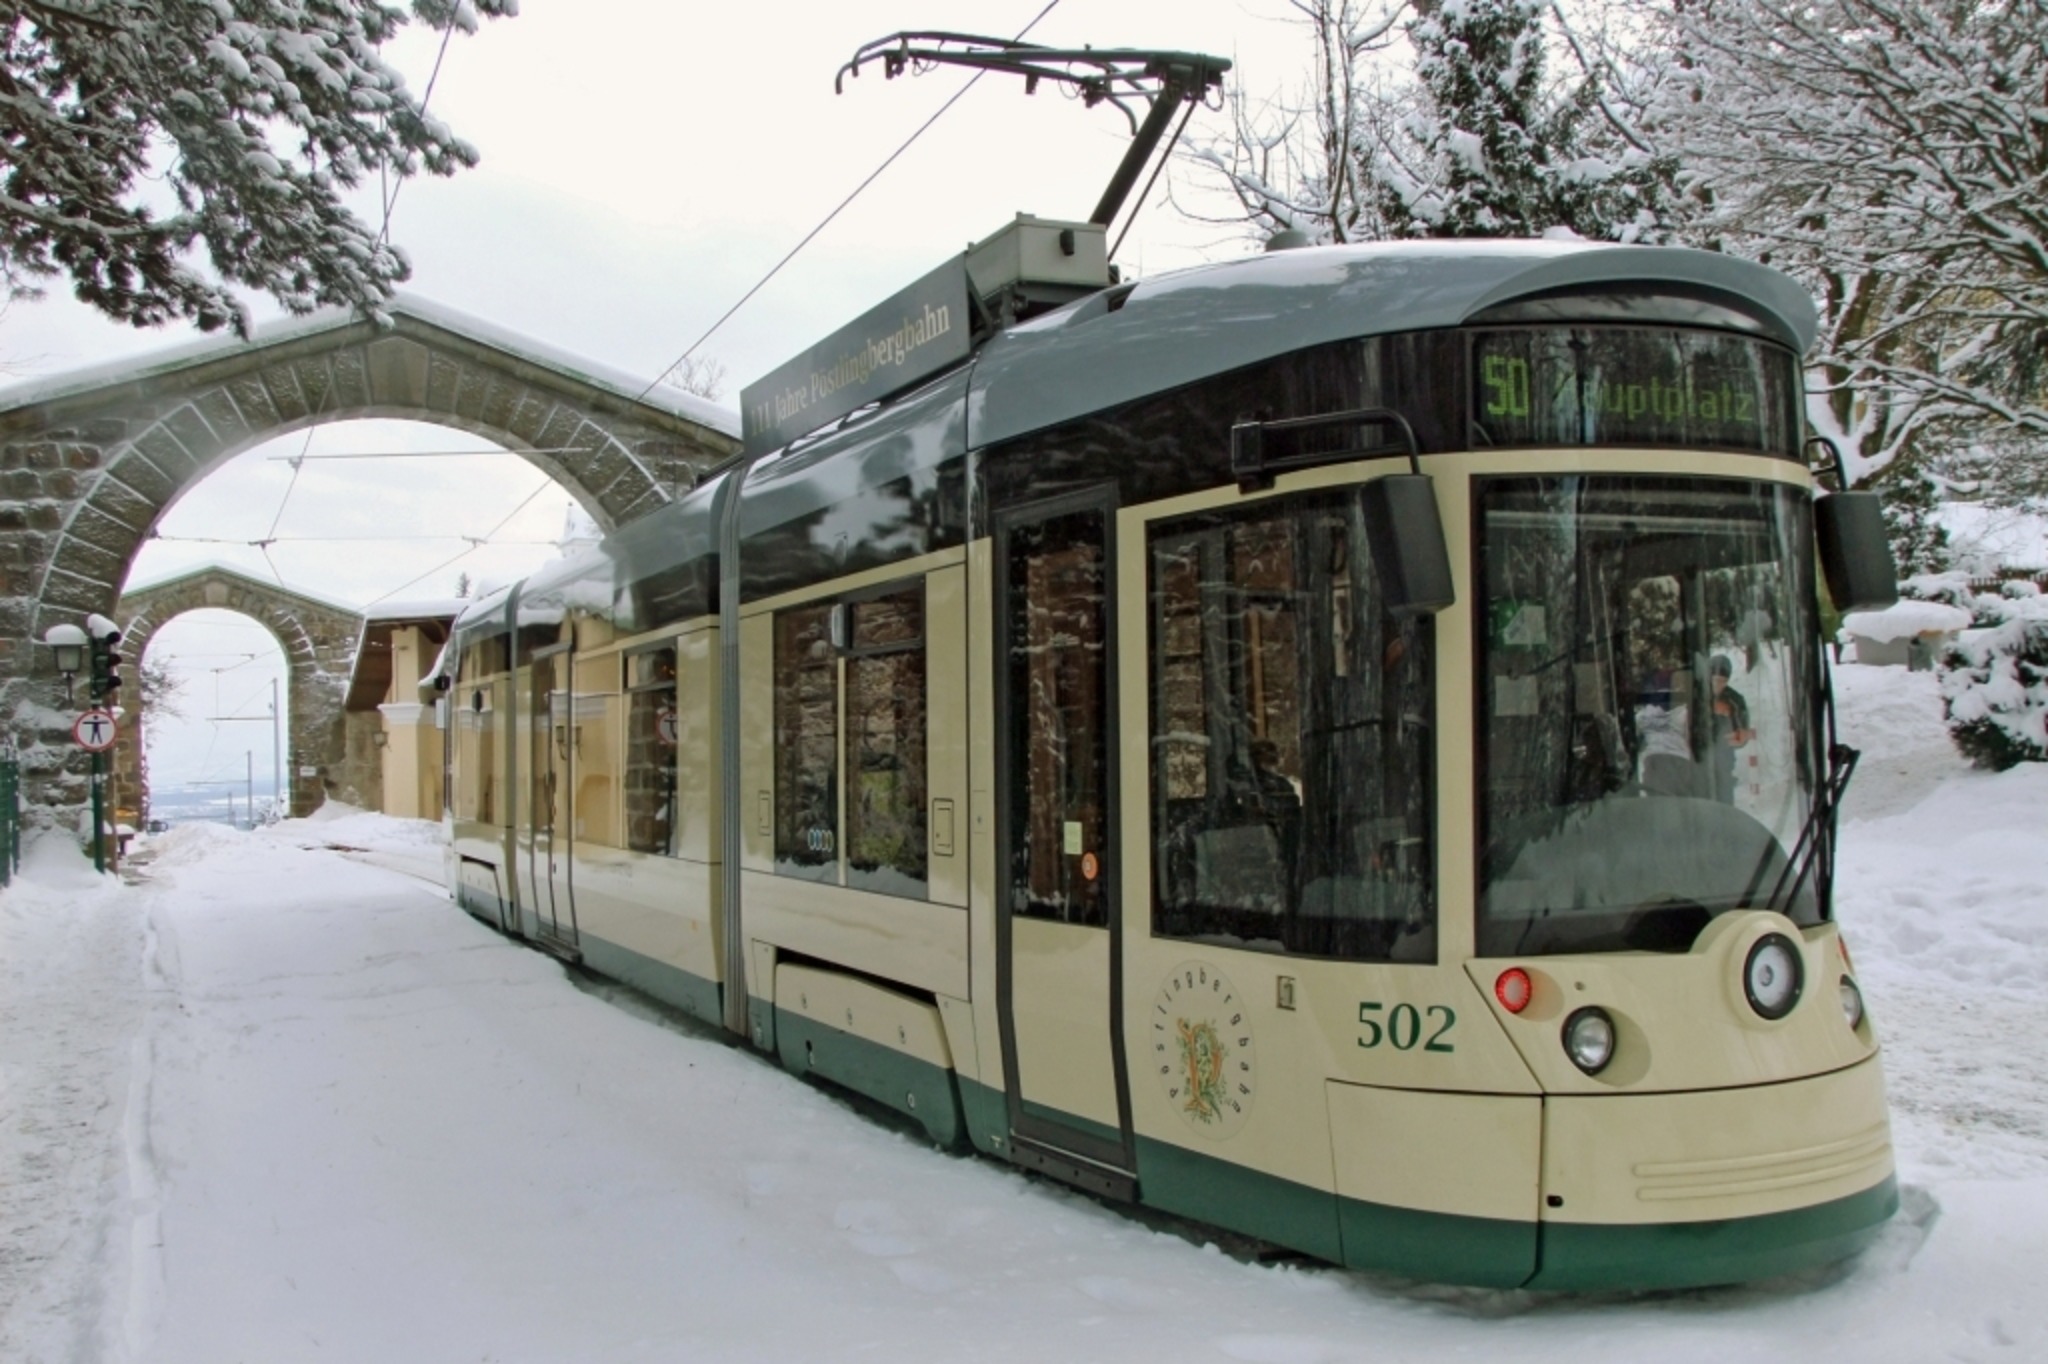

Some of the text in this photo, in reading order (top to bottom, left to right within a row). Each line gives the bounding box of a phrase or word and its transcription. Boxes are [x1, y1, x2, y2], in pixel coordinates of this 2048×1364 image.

[775, 386, 809, 430] Jahre
[1483, 353, 1530, 418] 50
[1357, 1001, 1456, 1053] 502
